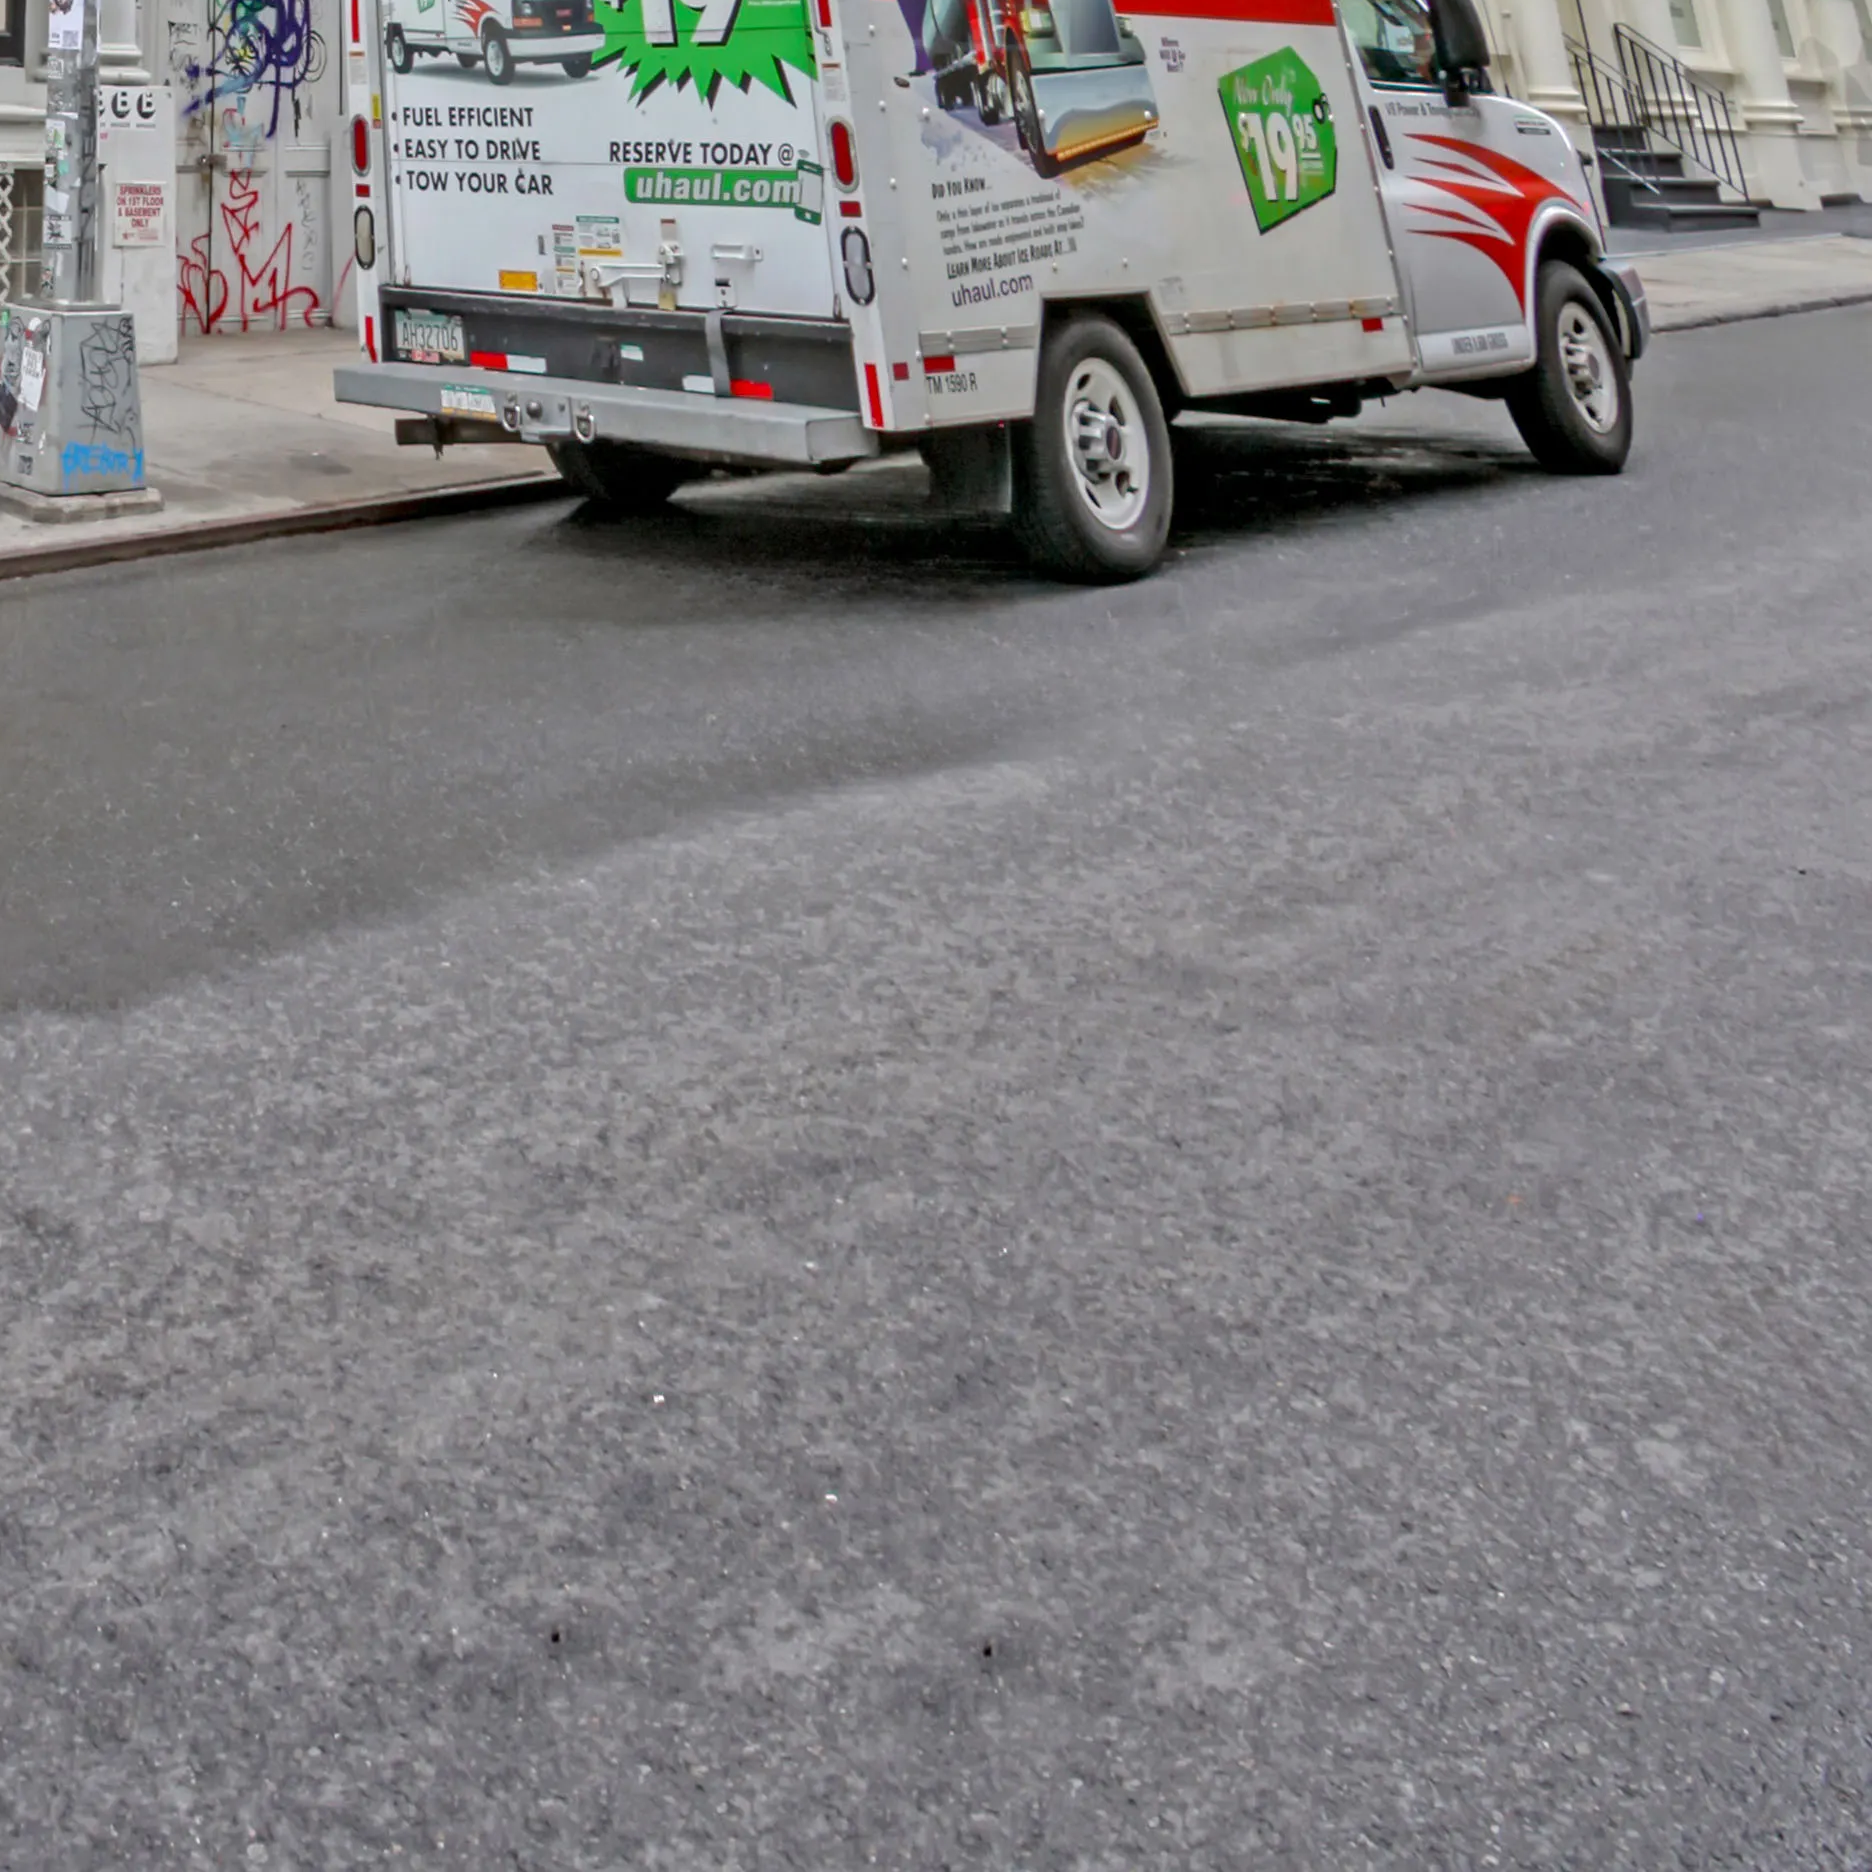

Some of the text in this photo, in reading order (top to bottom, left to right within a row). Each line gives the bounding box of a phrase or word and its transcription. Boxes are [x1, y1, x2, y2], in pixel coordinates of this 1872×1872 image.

[402, 106, 534, 128] FUEL EFFICIENT
[405, 138, 541, 162] EASY TO DRIVE
[609, 141, 795, 167] RESERVE TODAY @
[119, 184, 163, 196] SPRINKLERS
[406, 170, 554, 196] TOW YOUR CAR
[636, 171, 801, 204] uhaul.com
[124, 207, 161, 217] BASEMENT
[142, 196, 164, 206] FLOOR
[130, 218, 151, 228] ONLY
[946, 261, 970, 280] LEARN
[970, 255, 992, 273] MORE
[993, 251, 1017, 270] ABOUT
[951, 273, 1034, 308] uhaul.com
[402, 321, 458, 352] AH32706
[925, 375, 943, 395] TM
[968, 372, 978, 393] R
